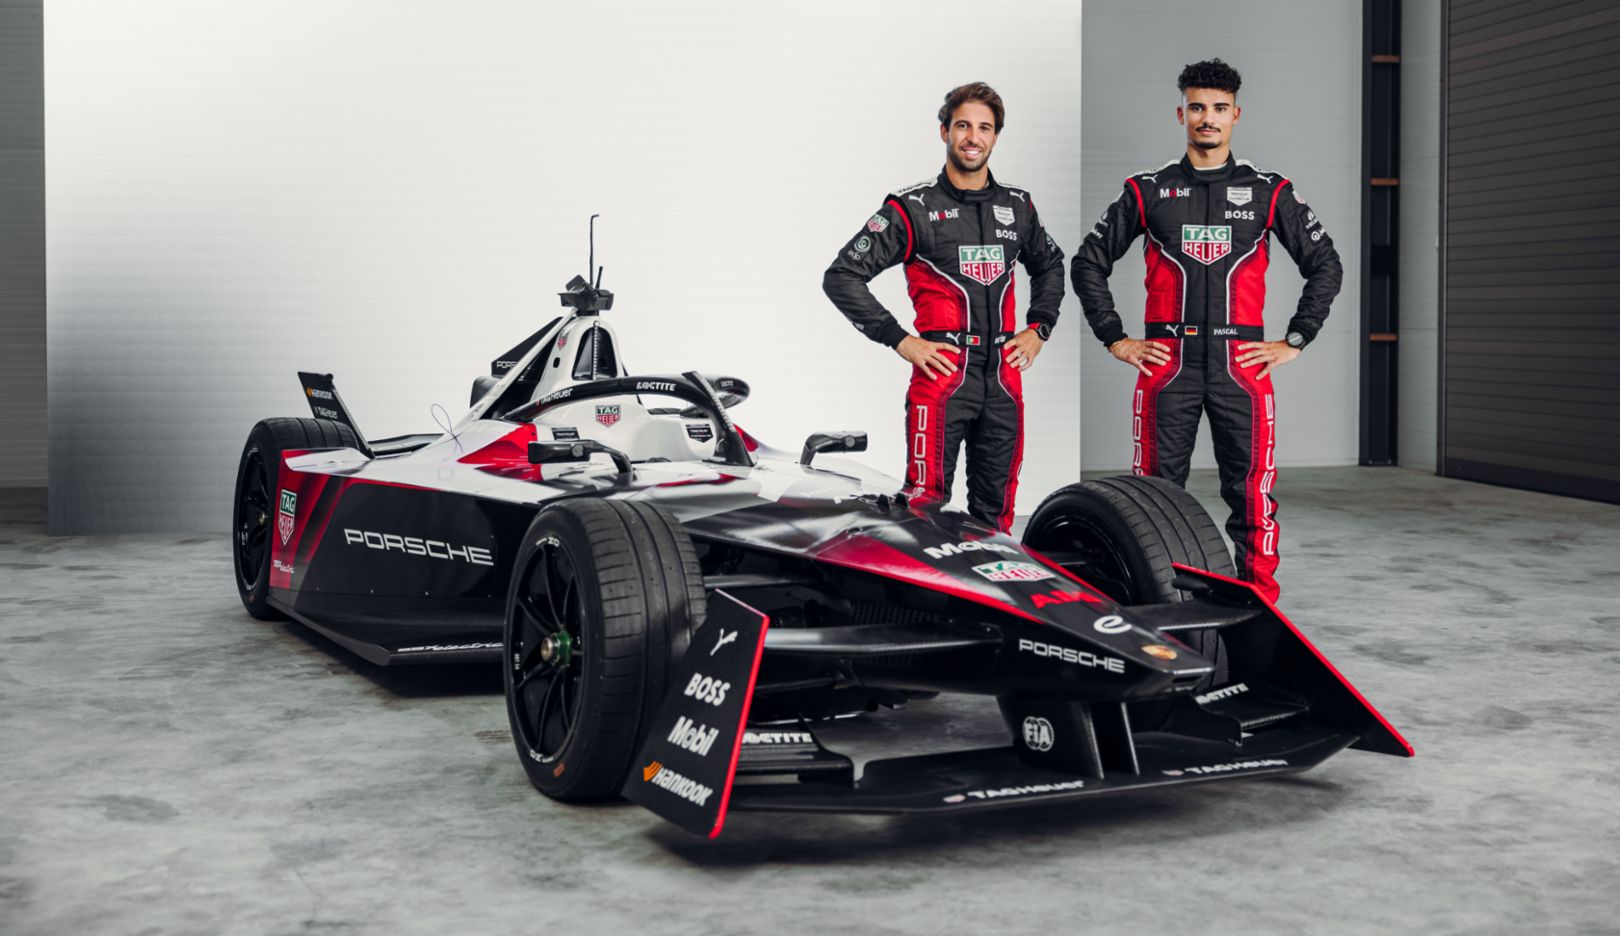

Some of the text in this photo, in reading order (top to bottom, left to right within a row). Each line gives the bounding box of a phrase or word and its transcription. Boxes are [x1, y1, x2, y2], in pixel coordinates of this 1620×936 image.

[1225, 210, 1255, 220] BOSS
[996, 229, 1017, 241] BOSS
[1185, 227, 1228, 241] TAG
[962, 247, 1002, 261] TAG
[1184, 242, 1230, 262] HEUER
[962, 263, 1004, 282] HEUER
[1213, 328, 1239, 336] PASCAL
[636, 381, 677, 391] LOCTITE
[599, 406, 619, 415] TAG
[282, 494, 295, 512] TAG
[344, 528, 494, 566] PORSCHE
[1019, 638, 1126, 674] PORSCHE
[684, 673, 731, 706] BOSS
[667, 716, 719, 757] Mobil
[1024, 721, 1052, 746] FIA
